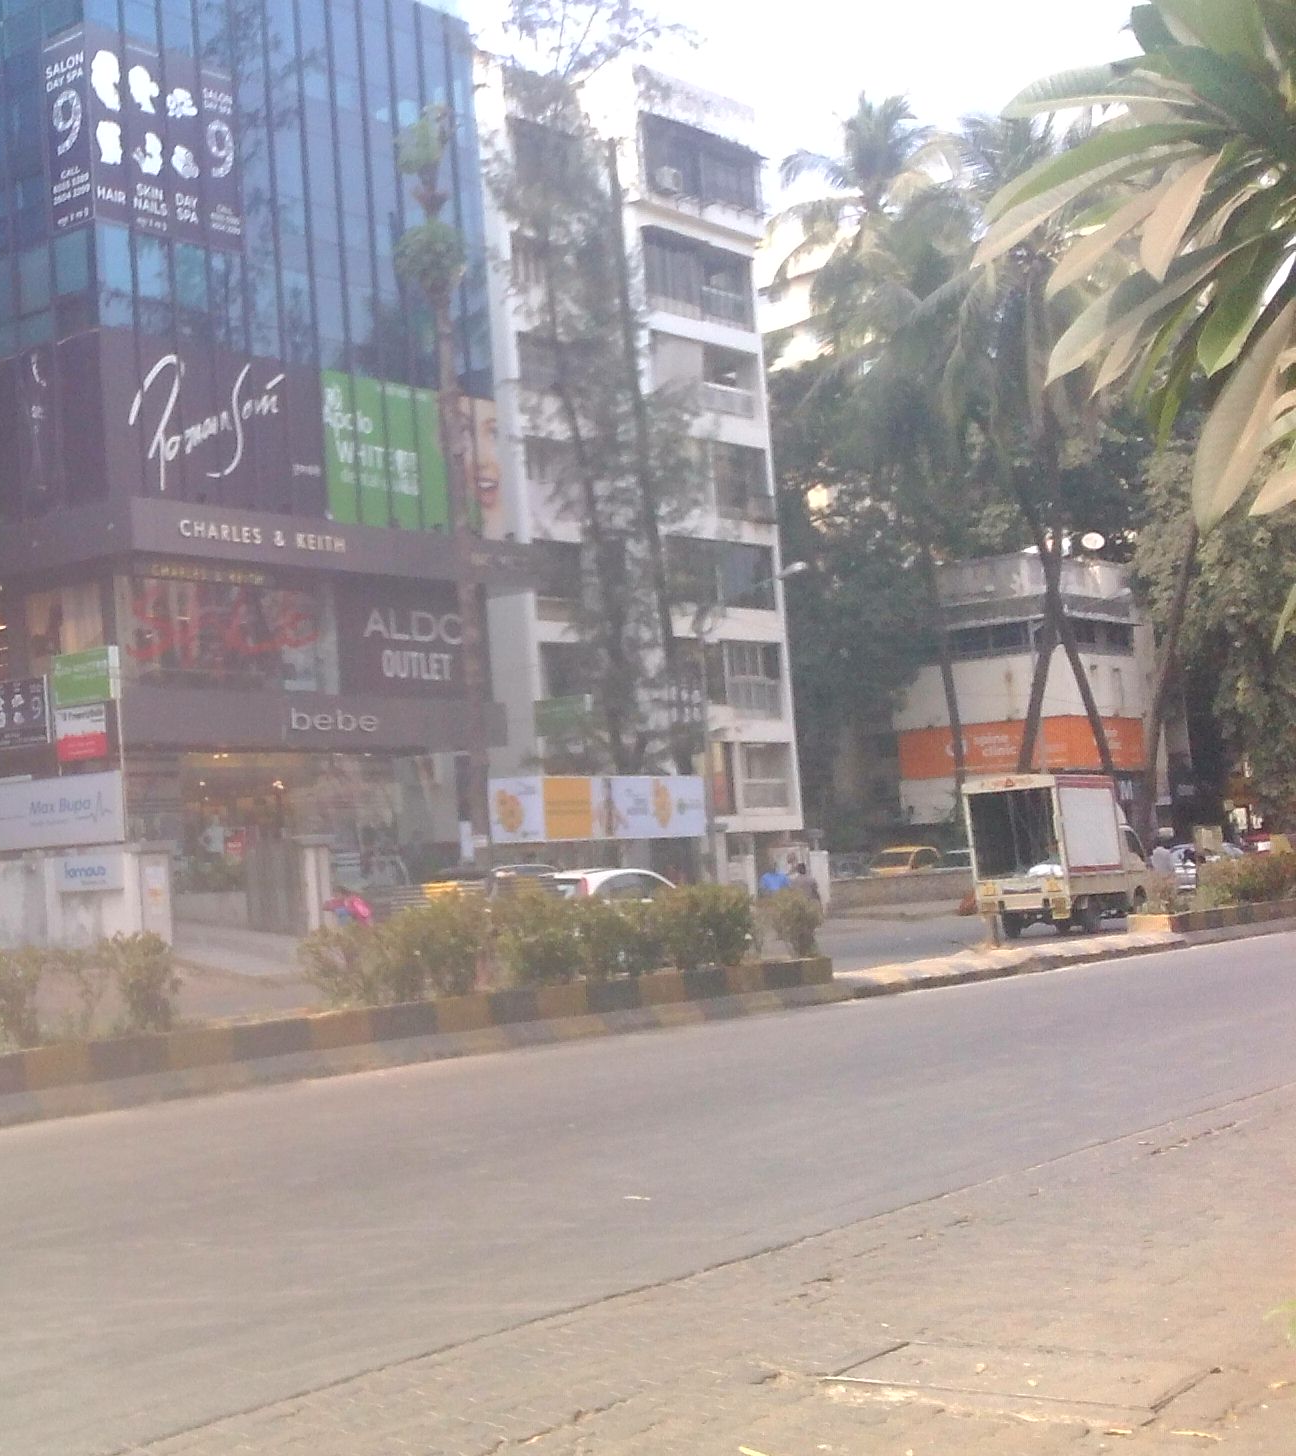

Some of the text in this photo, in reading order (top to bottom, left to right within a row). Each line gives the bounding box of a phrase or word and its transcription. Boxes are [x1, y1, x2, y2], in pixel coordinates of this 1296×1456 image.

[45, 50, 84, 79] SALON
[46, 67, 84, 93] DAY SPA
[53, 89, 82, 157] 9
[206, 119, 235, 178] 9
[97, 185, 126, 205] HAIR
[136, 183, 164, 201] SKIN
[175, 193, 198, 209] DAY
[133, 196, 168, 217] NAILS
[176, 207, 199, 224] SPA
[179, 519, 346, 553] CHARLES & KEITH
[382, 649, 452, 681] OUTLET
[289, 707, 380, 733] bebe
[29, 797, 91, 815] Max Bupa
